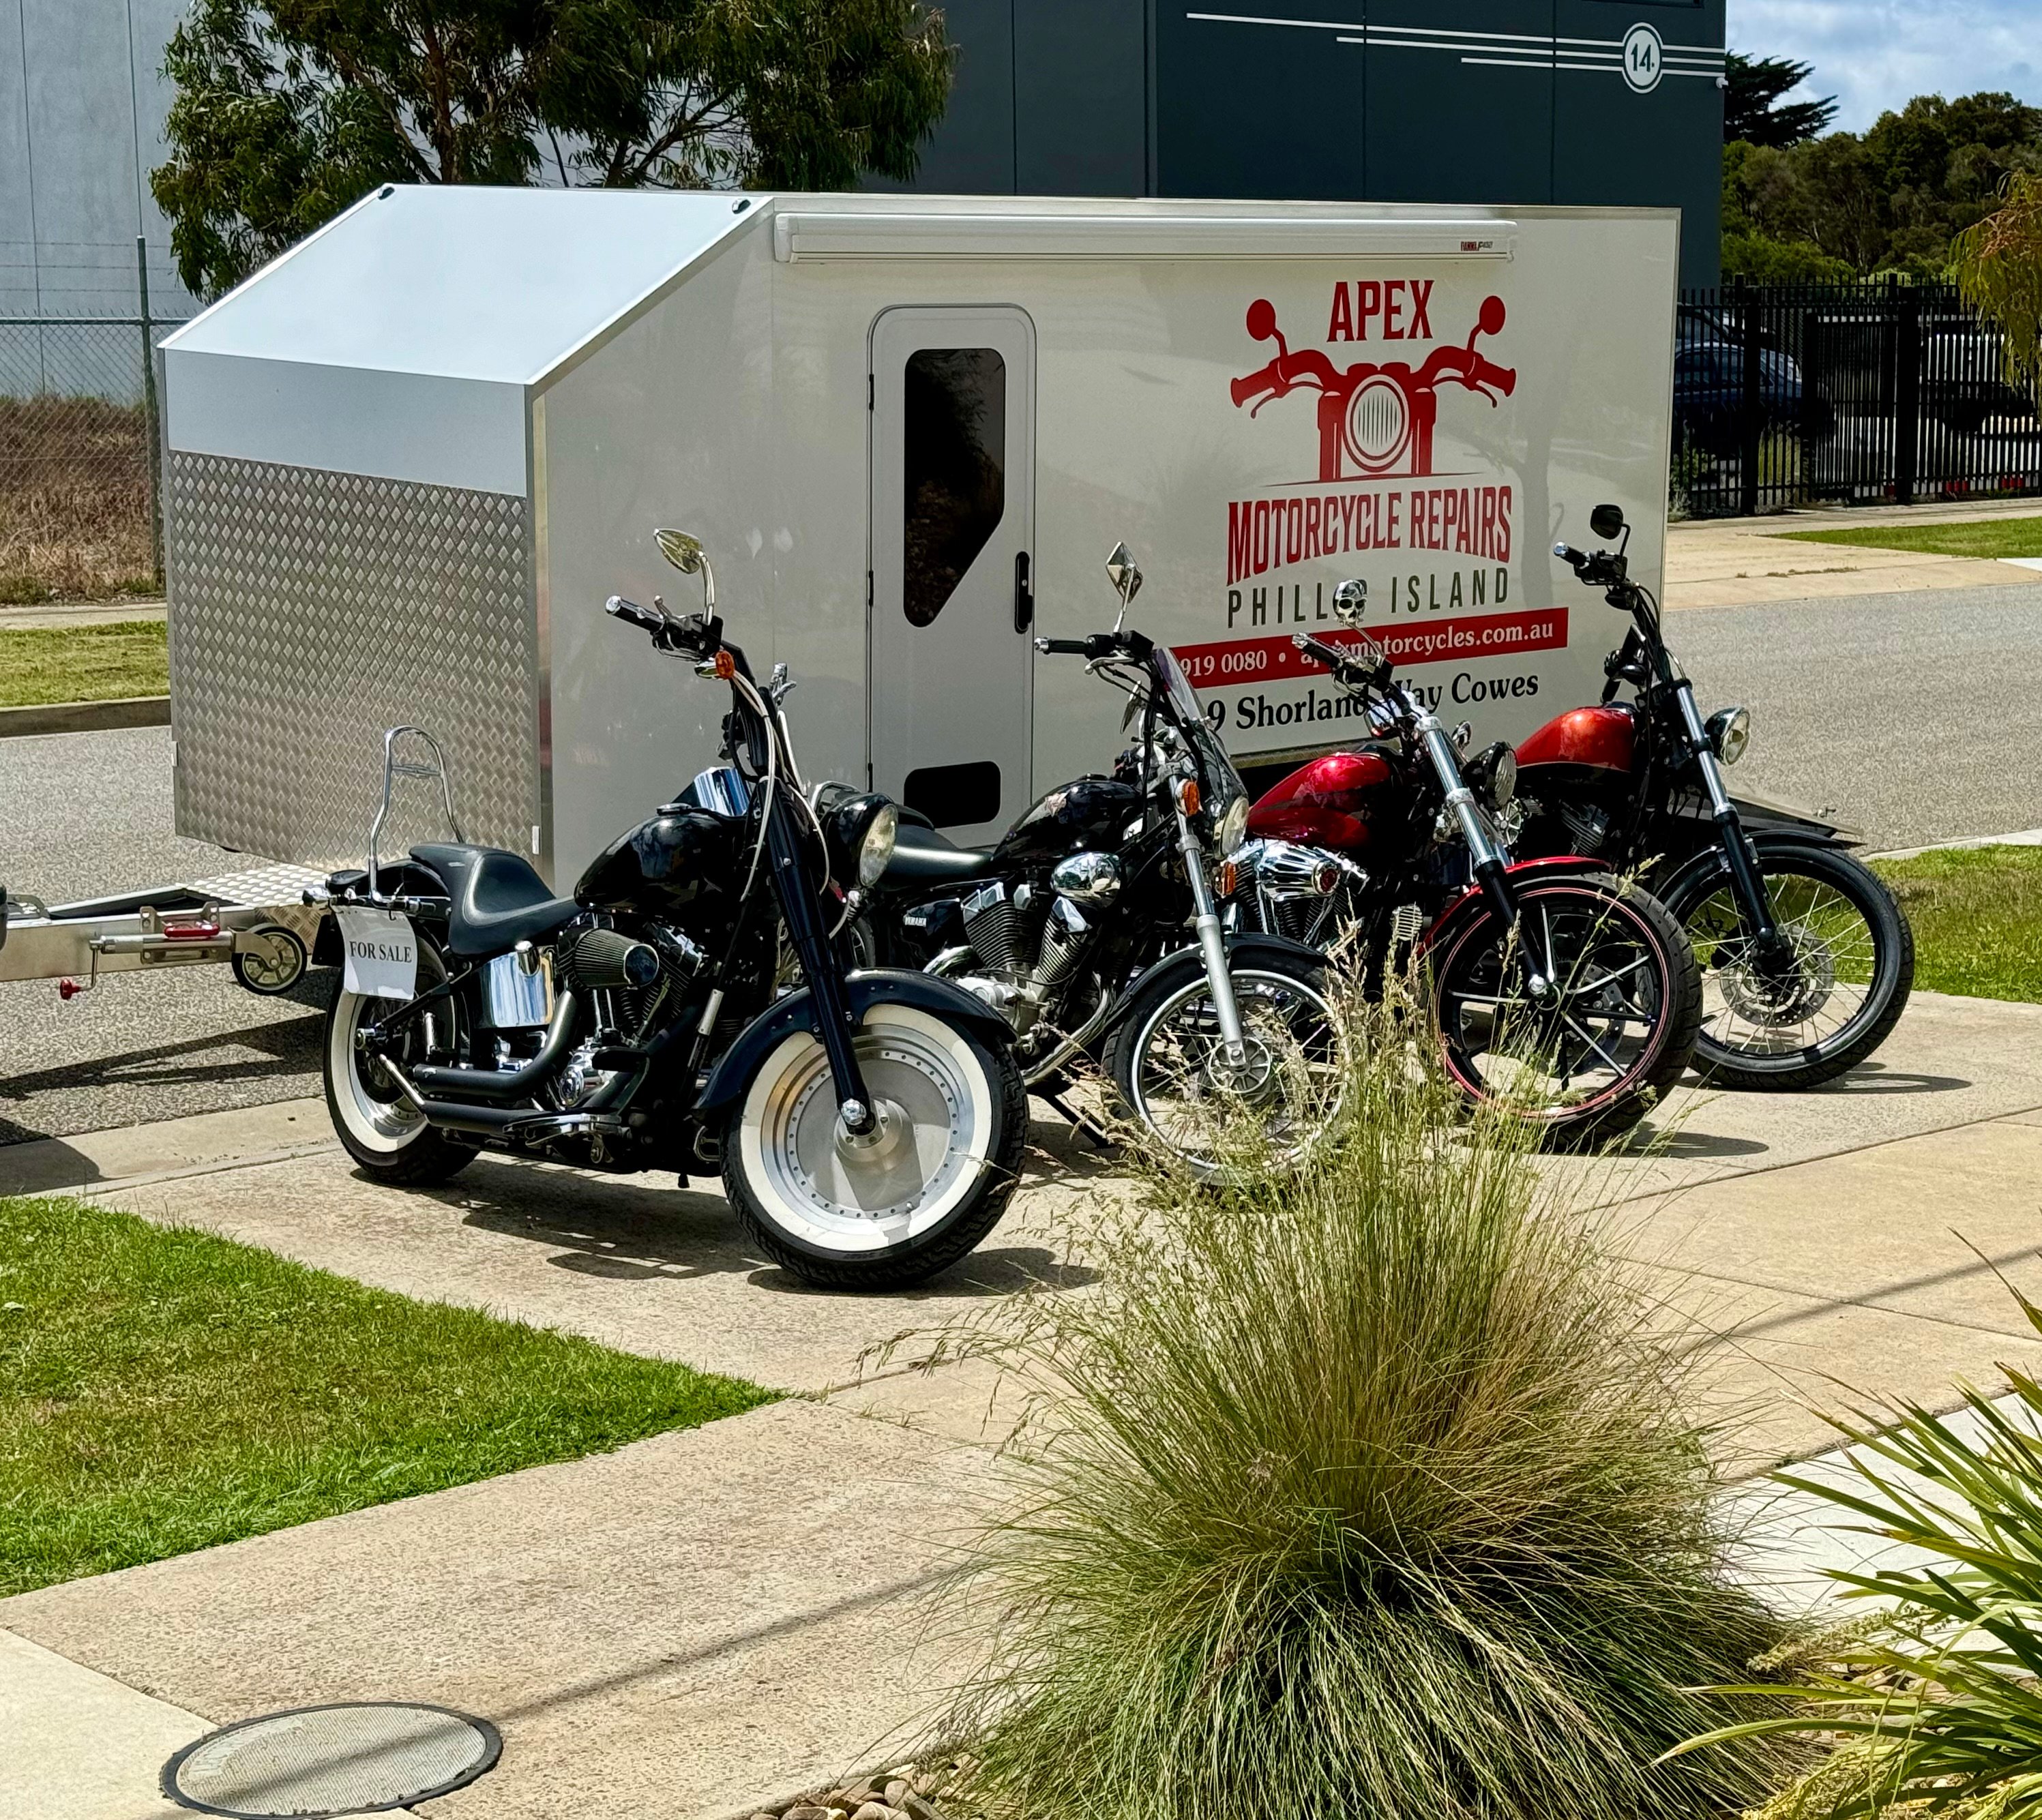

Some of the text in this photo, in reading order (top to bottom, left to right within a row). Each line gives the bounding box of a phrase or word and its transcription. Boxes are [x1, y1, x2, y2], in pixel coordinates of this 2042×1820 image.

[1327, 280, 1435, 342] APEX
[1227, 485, 1512, 587] MOTORCYCLE REPAIRS
[1228, 567, 1509, 629] PHILL ISLAND
[1221, 650, 1267, 673] 0080
[1301, 622, 1554, 668] amotorcycles.com.au
[1451, 673, 1539, 704] Cowes
[349, 940, 413, 963] FOR SALE
